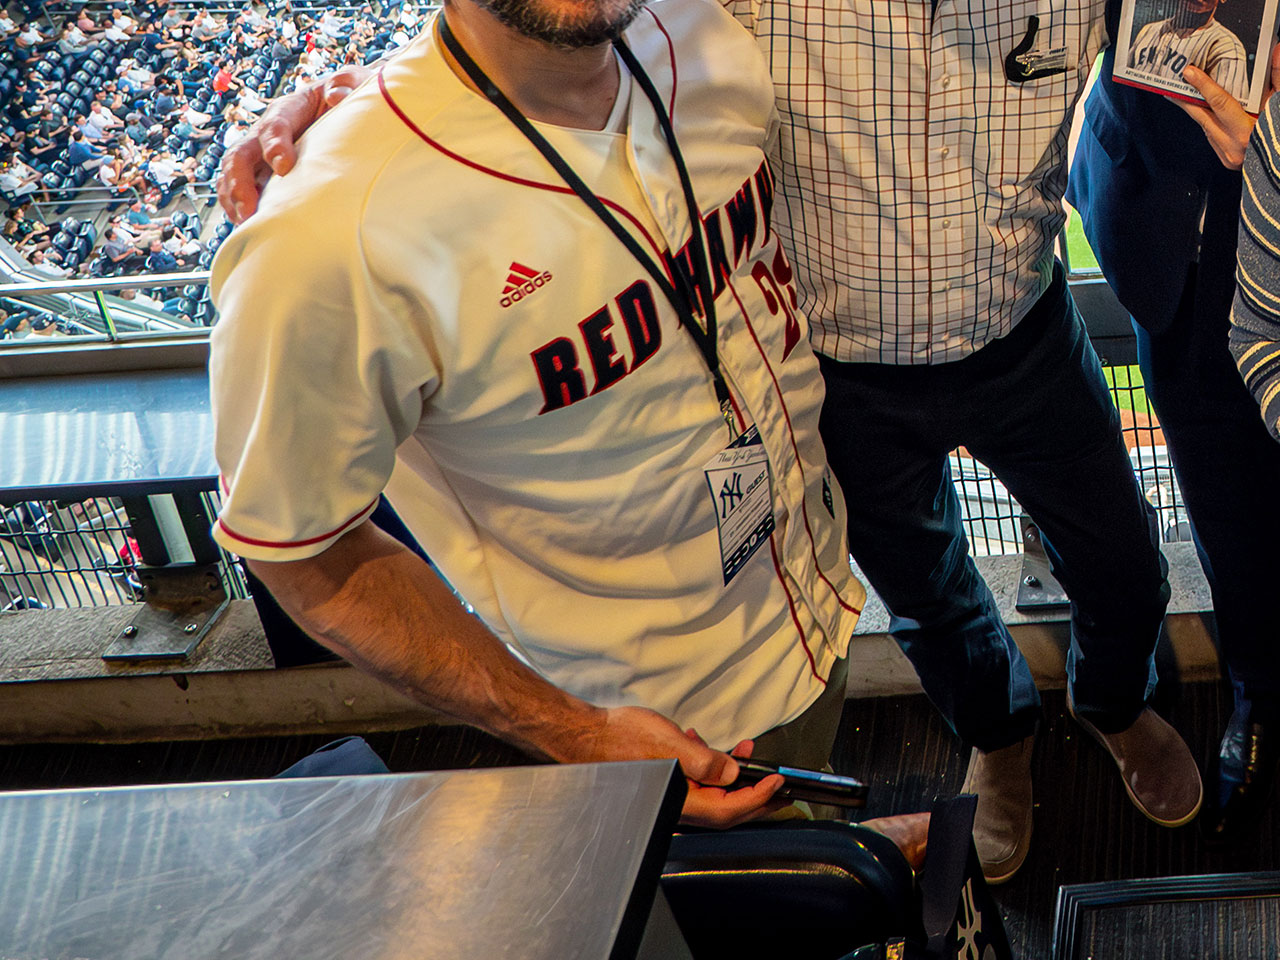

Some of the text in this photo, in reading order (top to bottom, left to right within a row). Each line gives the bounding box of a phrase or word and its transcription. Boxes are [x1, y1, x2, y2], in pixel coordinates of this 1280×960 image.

[500, 269, 553, 309] adidas
[530, 278, 663, 416] RED
[720, 472, 744, 518] NY
[746, 469, 766, 495] GUEST
